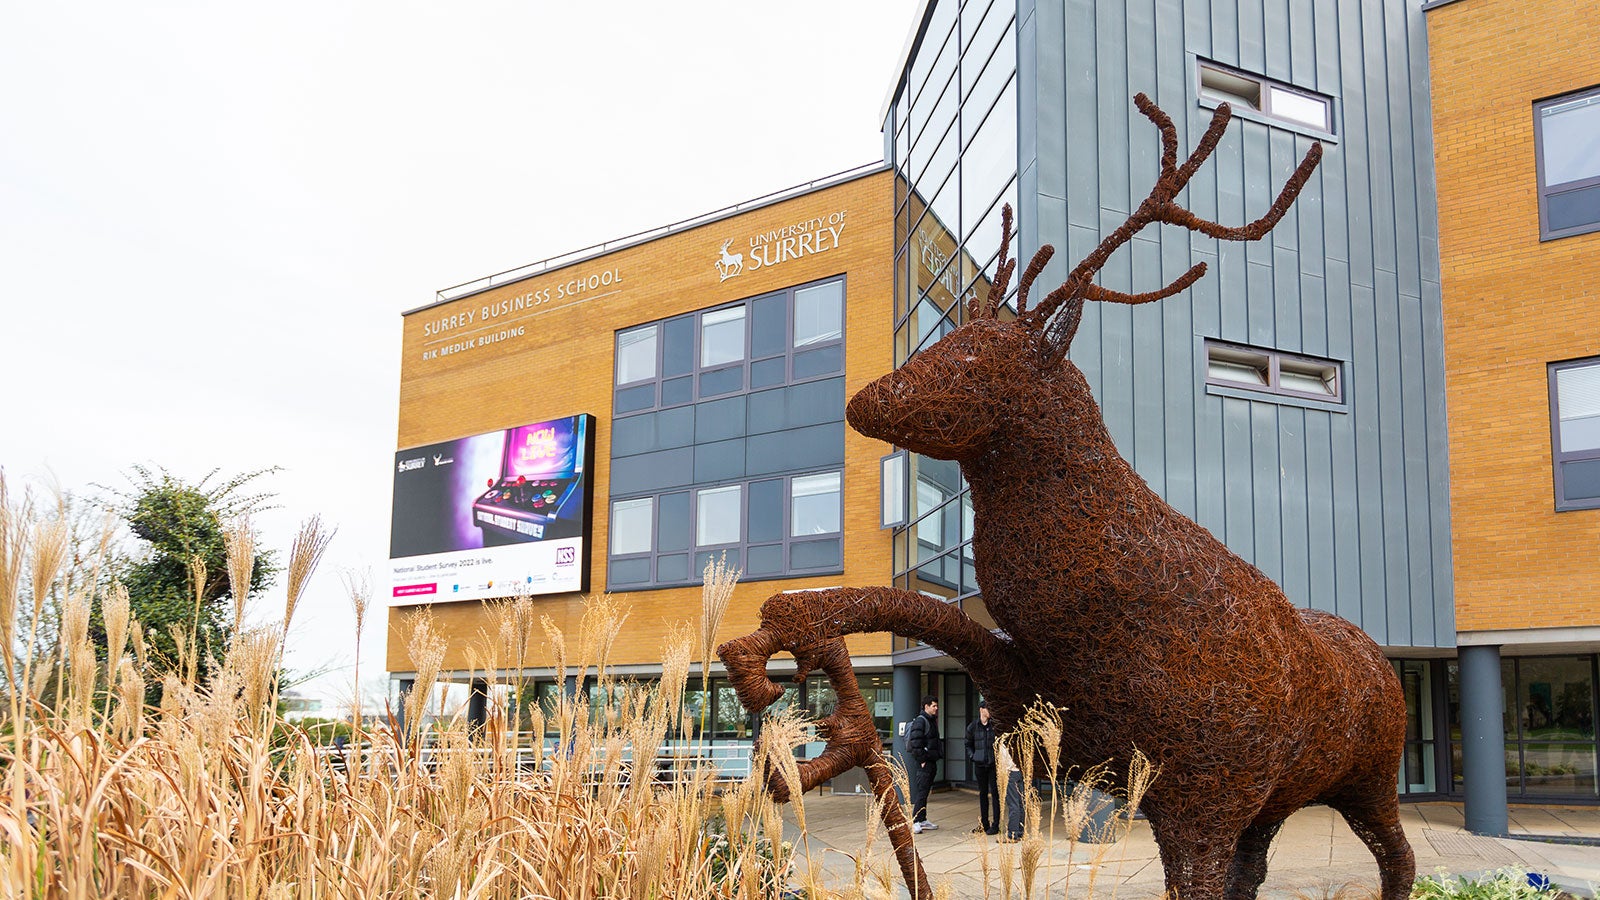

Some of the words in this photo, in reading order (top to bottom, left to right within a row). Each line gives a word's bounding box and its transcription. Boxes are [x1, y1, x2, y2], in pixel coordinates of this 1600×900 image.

[748, 222, 845, 271] SURREY
[750, 216, 825, 248] UNIVERSITY
[829, 210, 847, 225] OF
[423, 309, 476, 337] SURREY
[481, 288, 551, 321] BUSINESS
[557, 268, 623, 299] SCHOOL
[422, 349, 438, 361] RIK
[440, 339, 475, 356] MEDLIK
[478, 326, 525, 347] BUILDING
[526, 427, 555, 446] NOW
[459, 558, 474, 567] 2022
